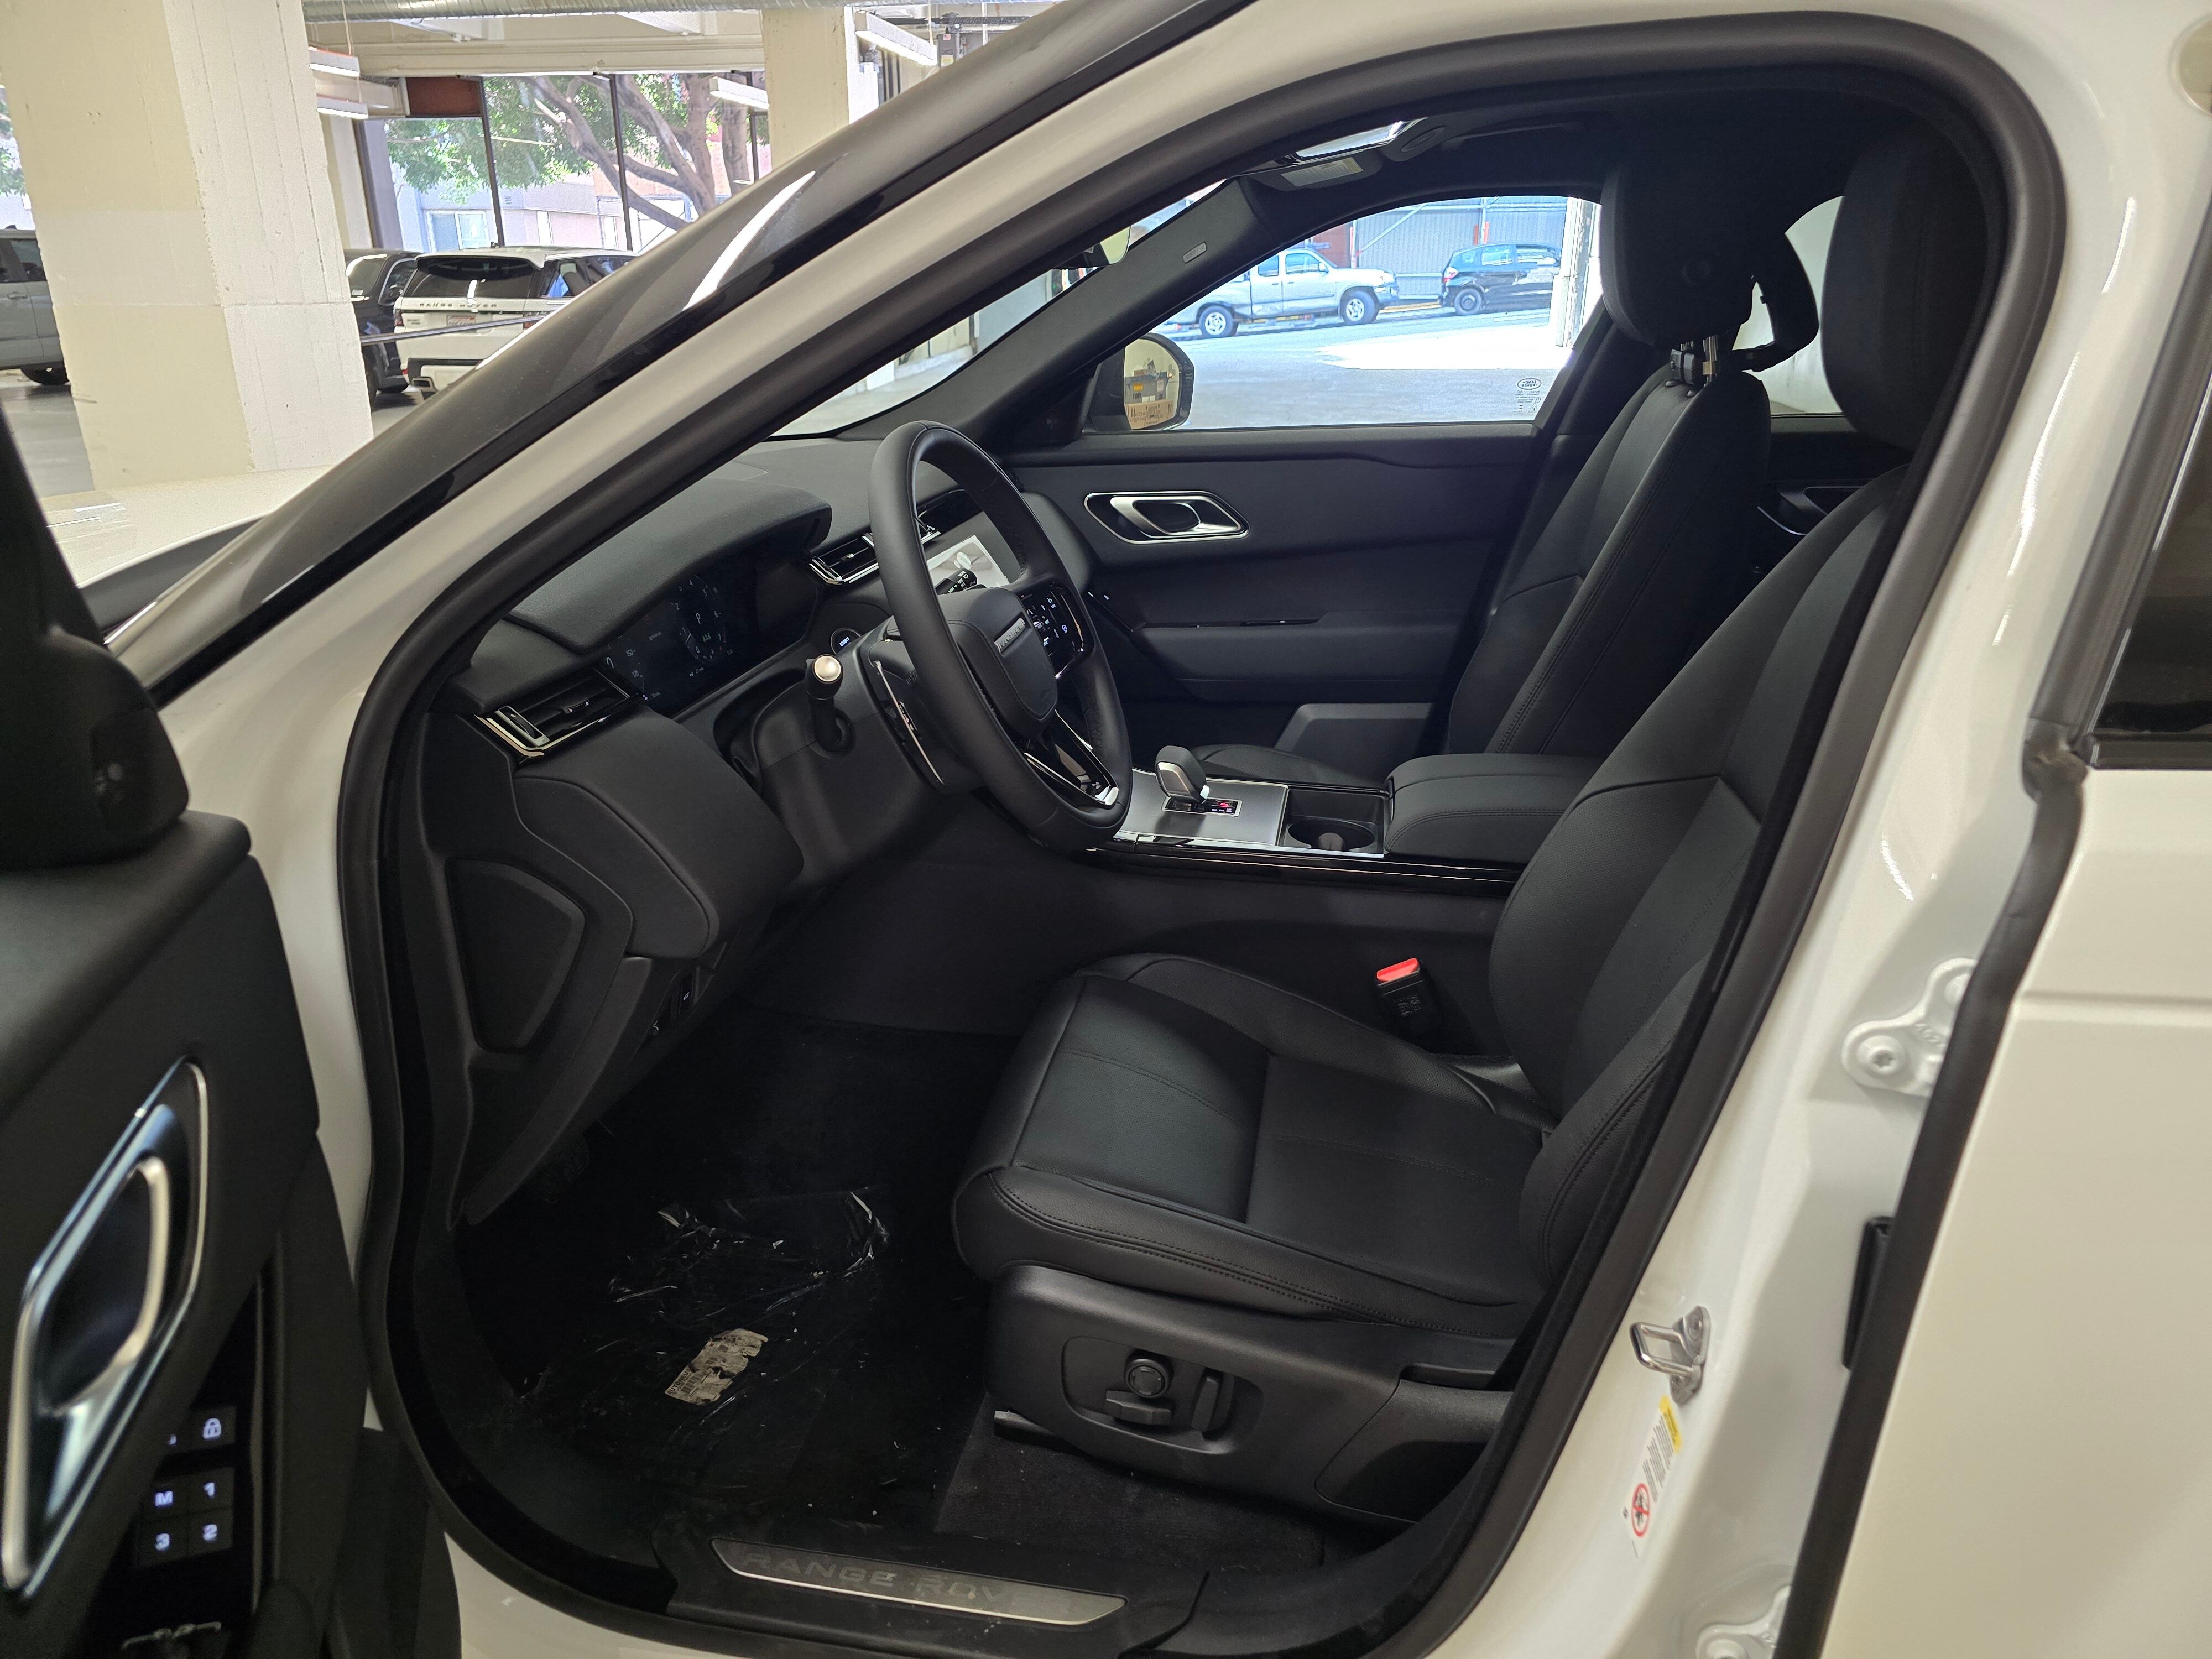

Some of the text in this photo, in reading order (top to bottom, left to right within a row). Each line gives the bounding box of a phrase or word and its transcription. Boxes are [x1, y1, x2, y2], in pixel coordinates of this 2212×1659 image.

[695, 612, 701, 625] P
[155, 1490, 173, 1507] M
[204, 1482, 216, 1498] 1
[202, 1524, 218, 1541] 2
[155, 1532, 170, 1551] 3
[743, 1552, 898, 1588] RANGE
